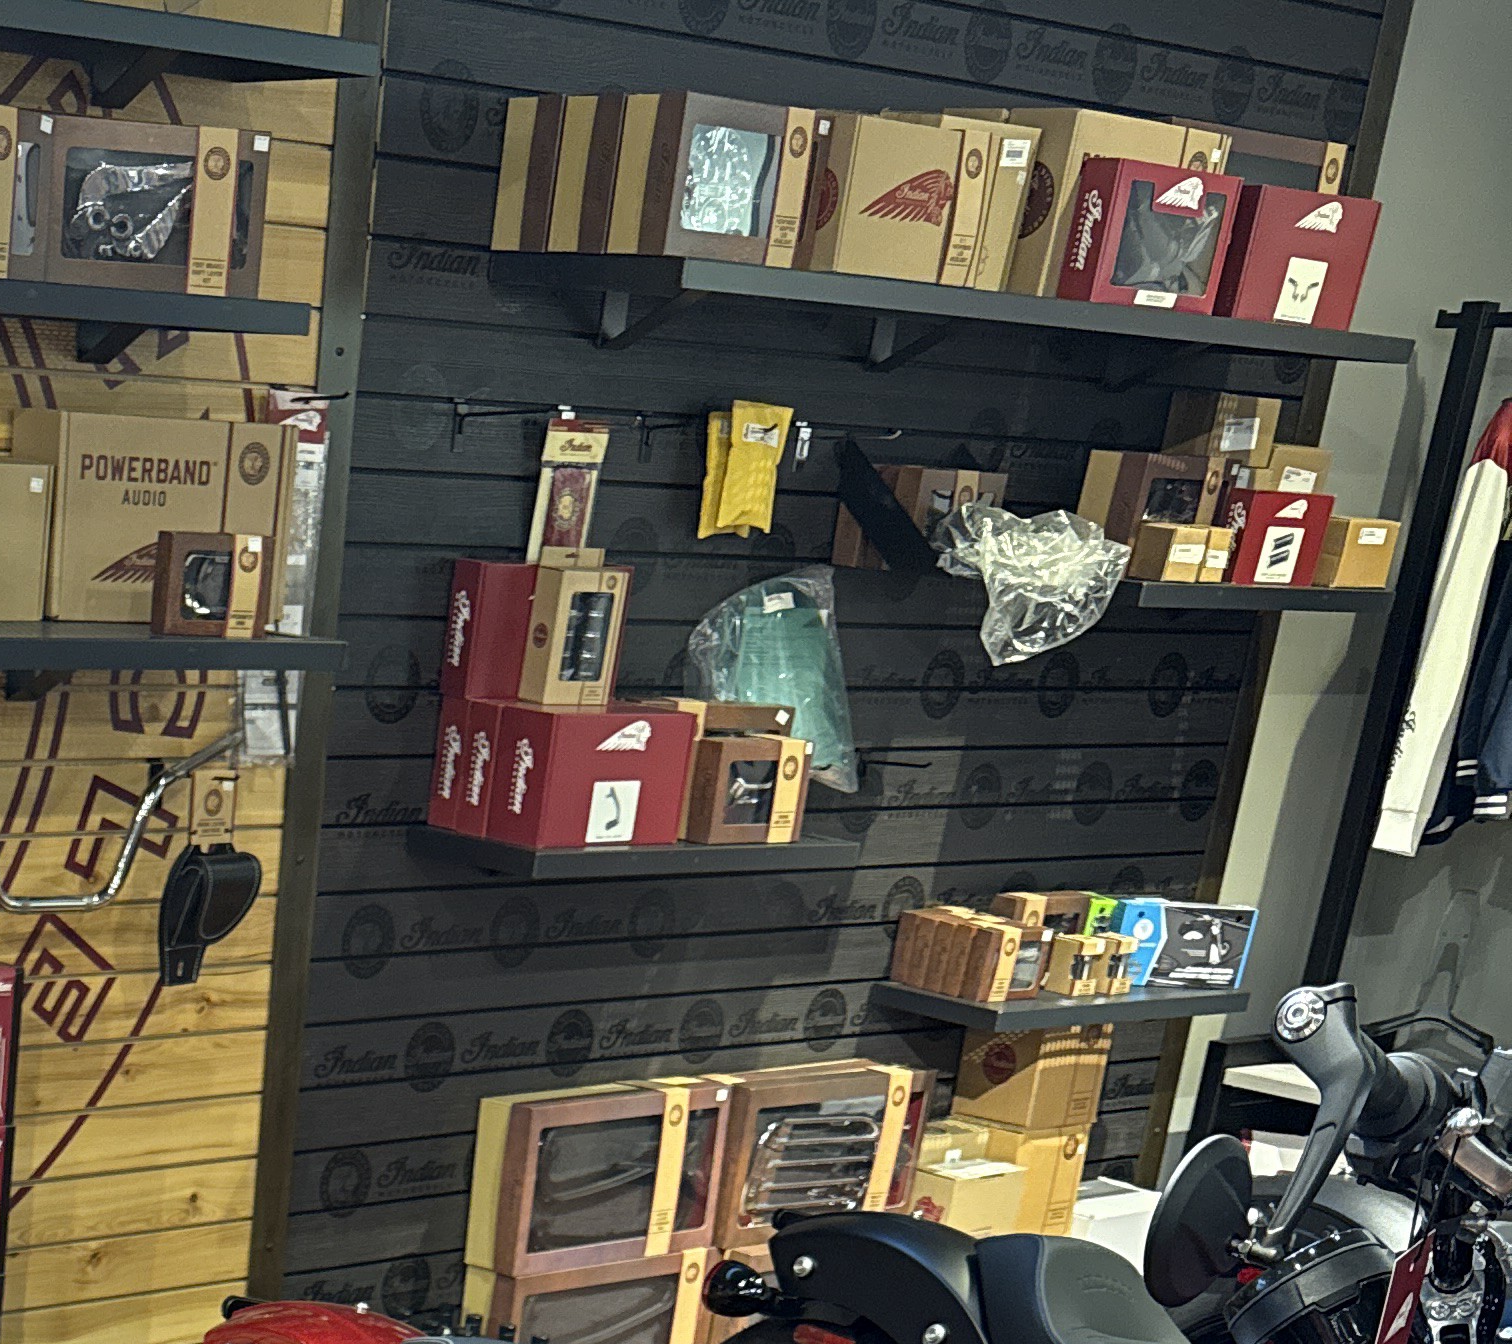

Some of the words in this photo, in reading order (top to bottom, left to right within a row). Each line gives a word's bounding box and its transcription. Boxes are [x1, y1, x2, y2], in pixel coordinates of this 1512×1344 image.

[882, 3, 960, 46] Indian
[1016, 27, 1088, 67] Indian
[1142, 46, 1209, 92] Indian
[1257, 73, 1321, 111] Indian
[1075, 189, 1102, 271] Indian
[390, 241, 479, 276] Indian
[80, 454, 212, 486] POWERBAND
[121, 490, 167, 507] AUDIO
[510, 738, 534, 814] Indian
[336, 794, 424, 826] Indian
[400, 914, 483, 950] Indian
[545, 906, 622, 941] Indian
[600, 1018, 673, 1052] Indian
[728, 1009, 799, 1039] Indian
[315, 1044, 397, 1080] Indian
[462, 1029, 540, 1064] Indian
[377, 1156, 455, 1190] Indian
